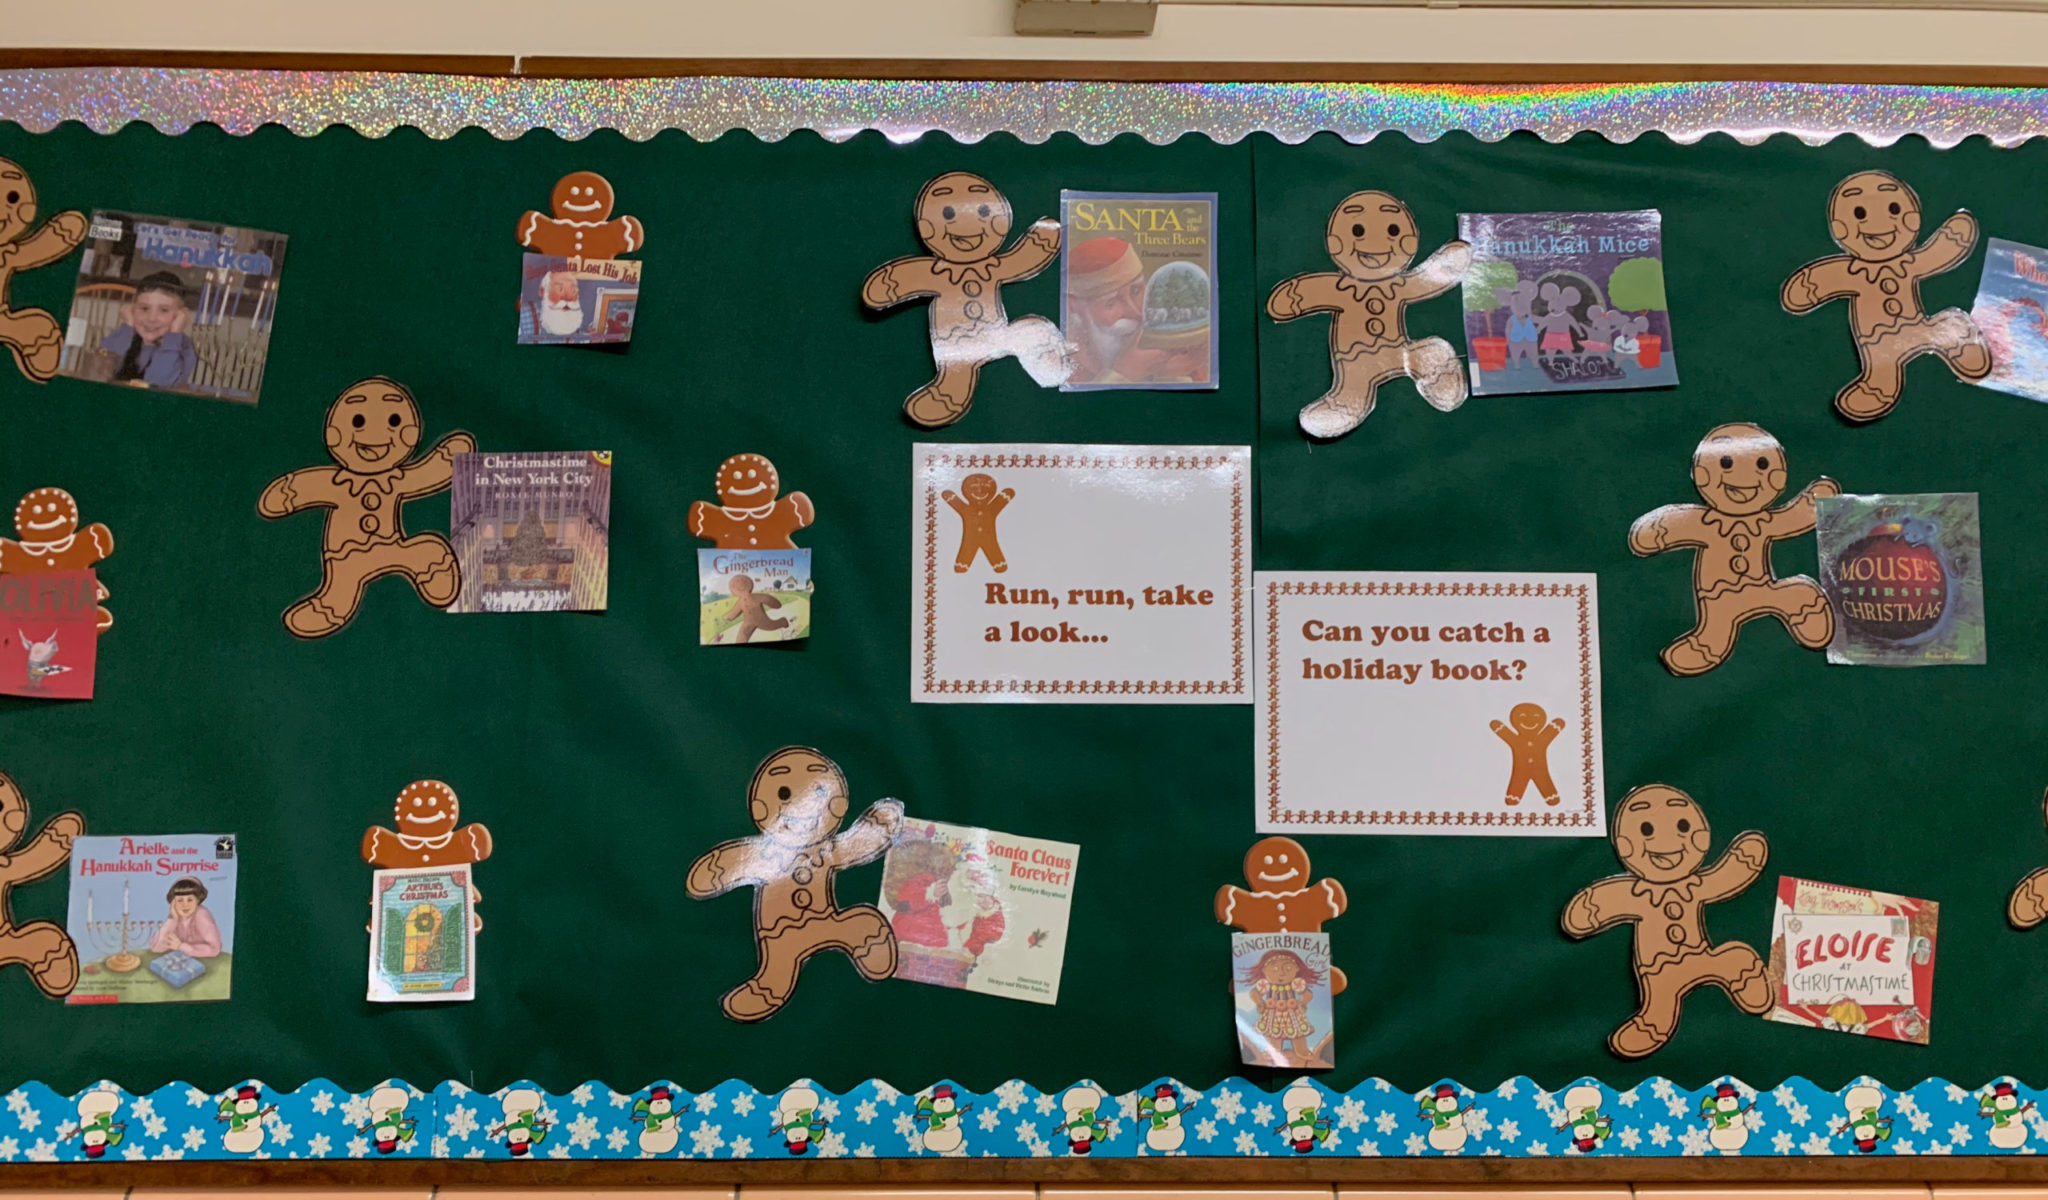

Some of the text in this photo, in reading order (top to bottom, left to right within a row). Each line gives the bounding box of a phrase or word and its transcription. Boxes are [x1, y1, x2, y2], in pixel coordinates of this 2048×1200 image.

[1075, 201, 1184, 232] SANTA
[1187, 214, 1202, 224] and
[91, 226, 119, 239] Books
[1186, 223, 1200, 232] the
[1134, 232, 1206, 245] Three Bears
[1598, 236, 1650, 254] Mice
[143, 237, 273, 276] Hanukkah
[580, 259, 601, 274] Lost
[602, 262, 619, 279] His
[619, 268, 638, 285] Job
[484, 456, 587, 469] Christmastime
[475, 472, 594, 487] in New York City
[713, 555, 794, 575] Gingerbread
[764, 567, 789, 578] Man
[1839, 556, 1942, 583] MOUSE'S
[0, 578, 97, 613] OLIVIA
[984, 582, 1214, 610] Run, run, take
[1858, 587, 1922, 597] FIRST
[1842, 599, 1943, 623] CHRISTMAS
[984, 621, 1108, 643] a look...
[1302, 619, 1551, 647] Can you catch a
[1302, 658, 1527, 685] holiday book?
[119, 837, 198, 856] Arielle and the
[986, 840, 1072, 870] Santa Claus
[80, 857, 219, 876] Hanukkah Surprise
[1010, 862, 1070, 887] Forever!
[399, 890, 448, 901] CHRISTMAS
[1795, 930, 1896, 969] ELOISE
[1839, 962, 1852, 971] AT
[1793, 973, 1910, 996] CHRISTMASTIME
